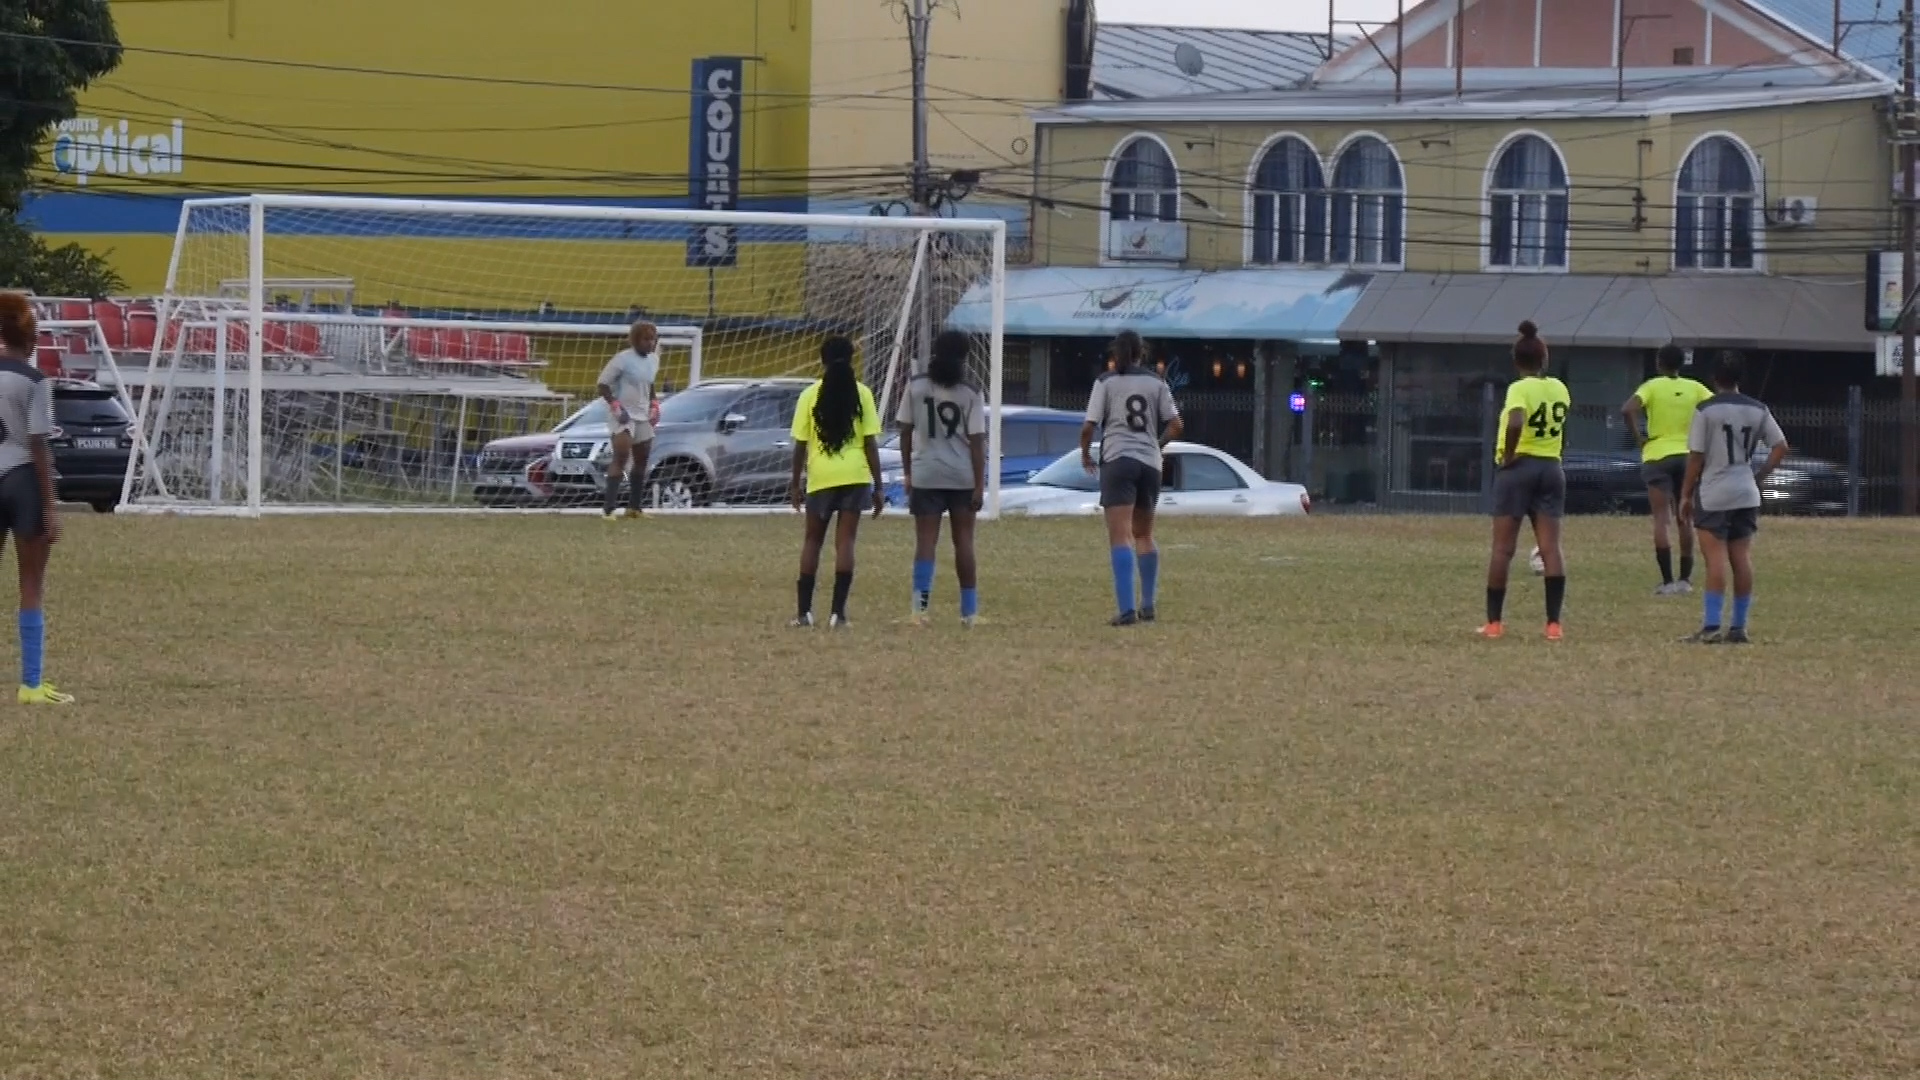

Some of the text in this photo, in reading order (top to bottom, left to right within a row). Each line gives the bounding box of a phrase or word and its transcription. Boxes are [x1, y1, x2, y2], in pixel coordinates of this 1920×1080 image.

[924, 396, 961, 438] 19
[1126, 393, 1148, 432] 8
[1528, 401, 1567, 437] 49
[1722, 424, 1752, 464] 11
